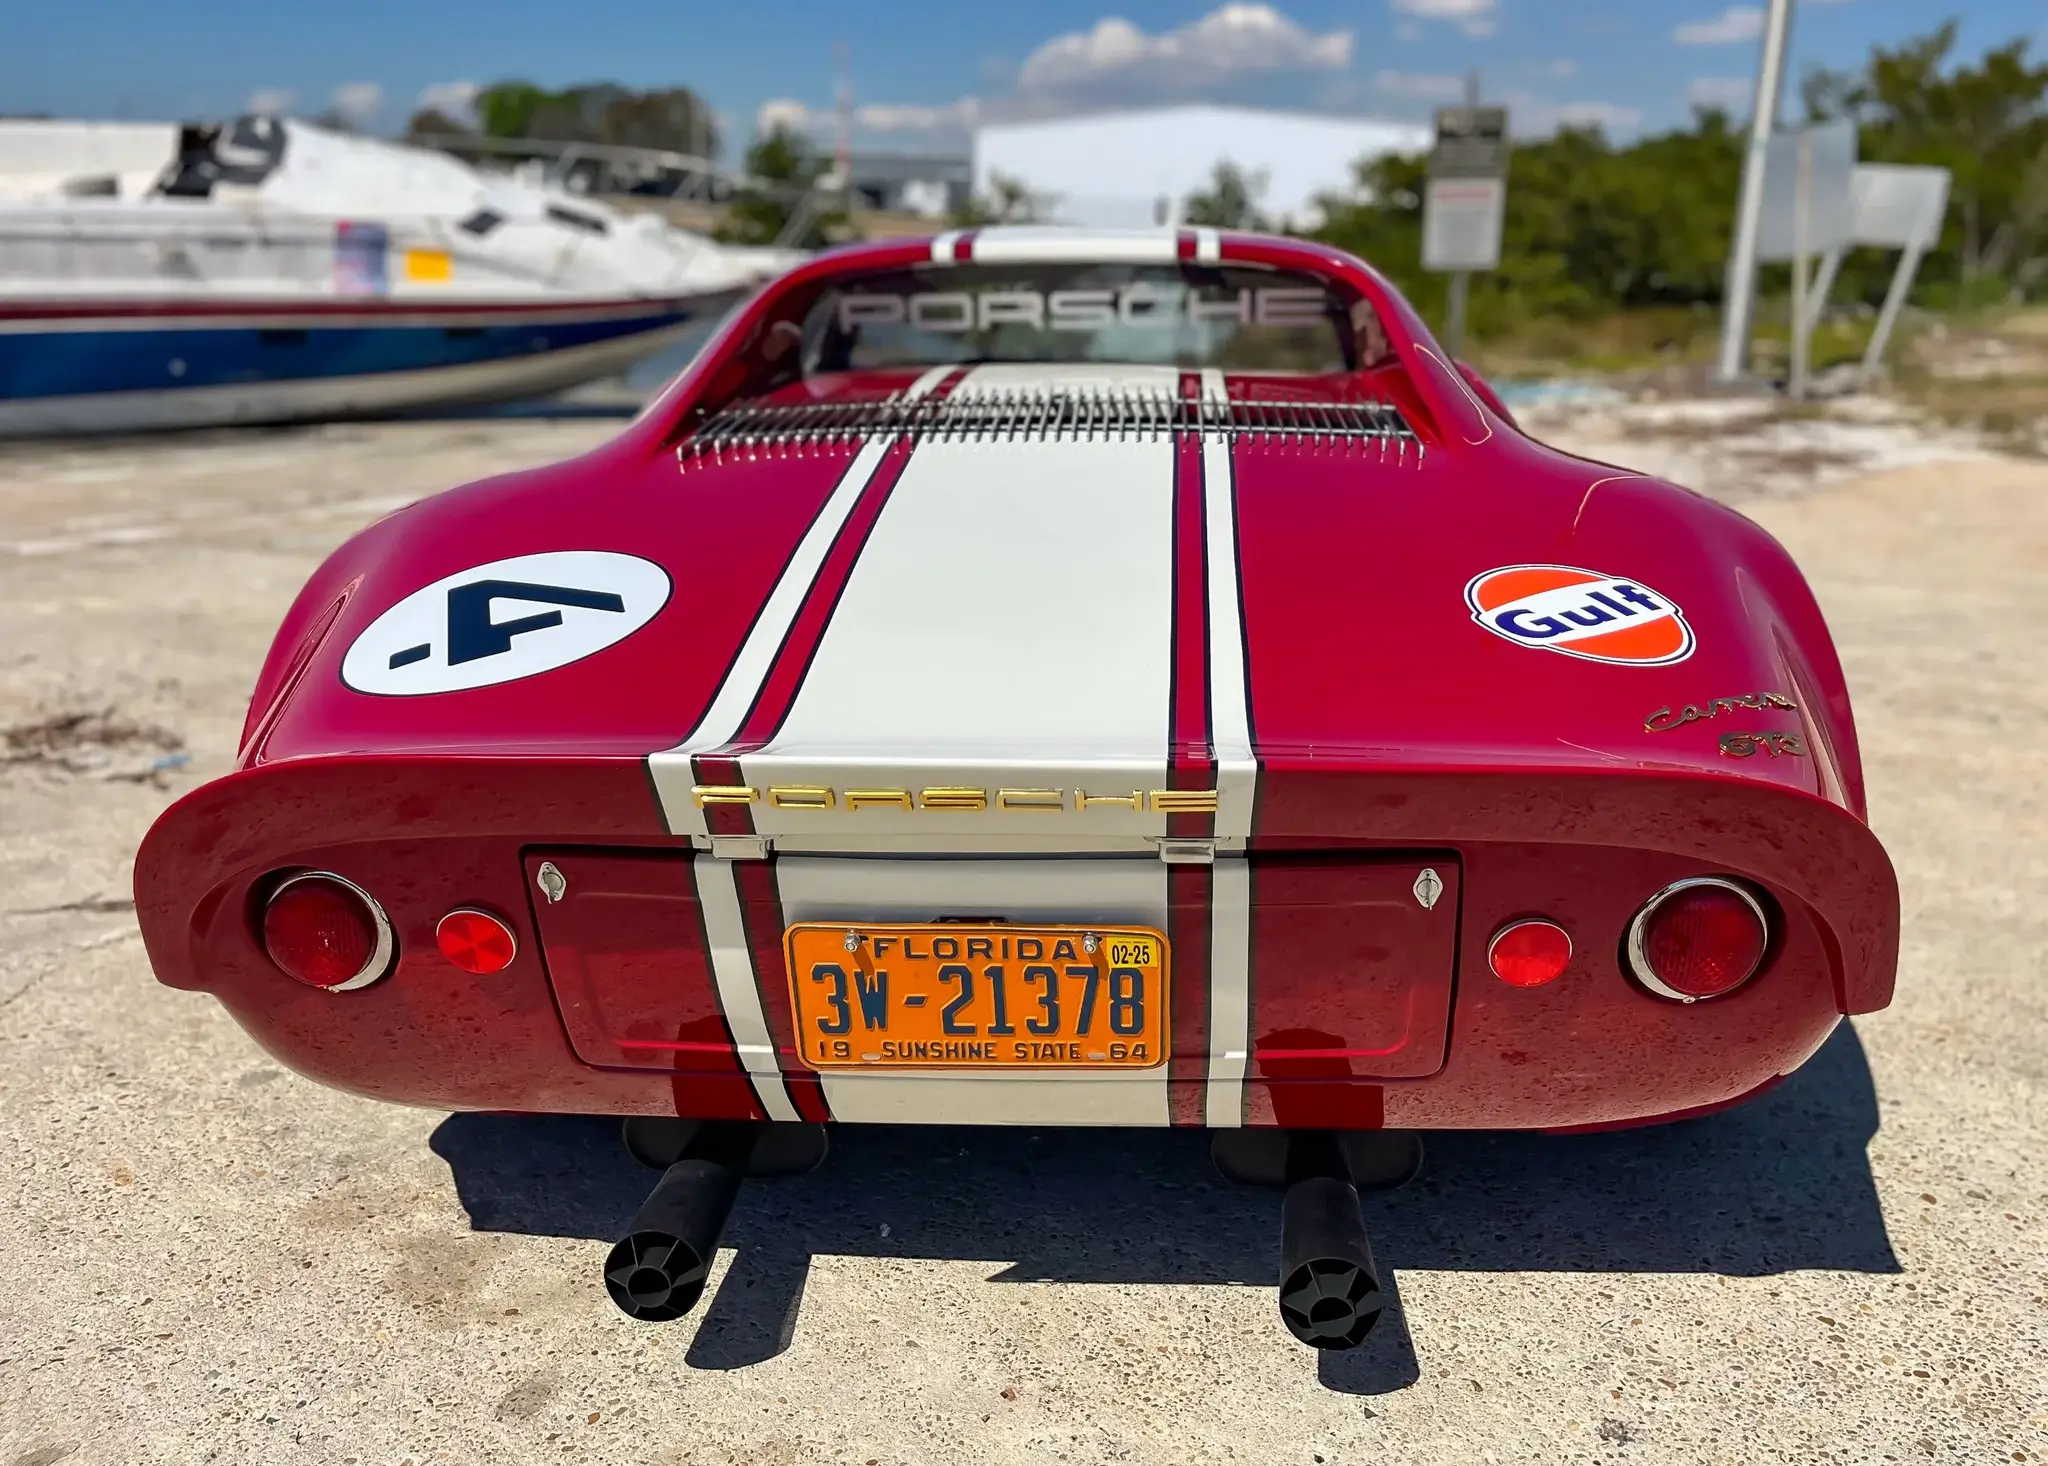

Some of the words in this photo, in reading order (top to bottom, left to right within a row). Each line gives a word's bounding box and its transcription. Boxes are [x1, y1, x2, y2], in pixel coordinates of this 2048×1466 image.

[839, 288, 1325, 334] PORSCHE
[1494, 584, 1664, 640] Gulf
[692, 785, 1218, 812] PORSCHE
[873, 936, 1078, 962] FLORIDA
[1112, 944, 1150, 965] 02-25
[811, 963, 1146, 1037] 3W-21378
[819, 1040, 850, 1058] 19
[882, 1041, 997, 1060] SUNSHINE
[1014, 1042, 1081, 1061] STATE
[1109, 1042, 1148, 1061] 64
